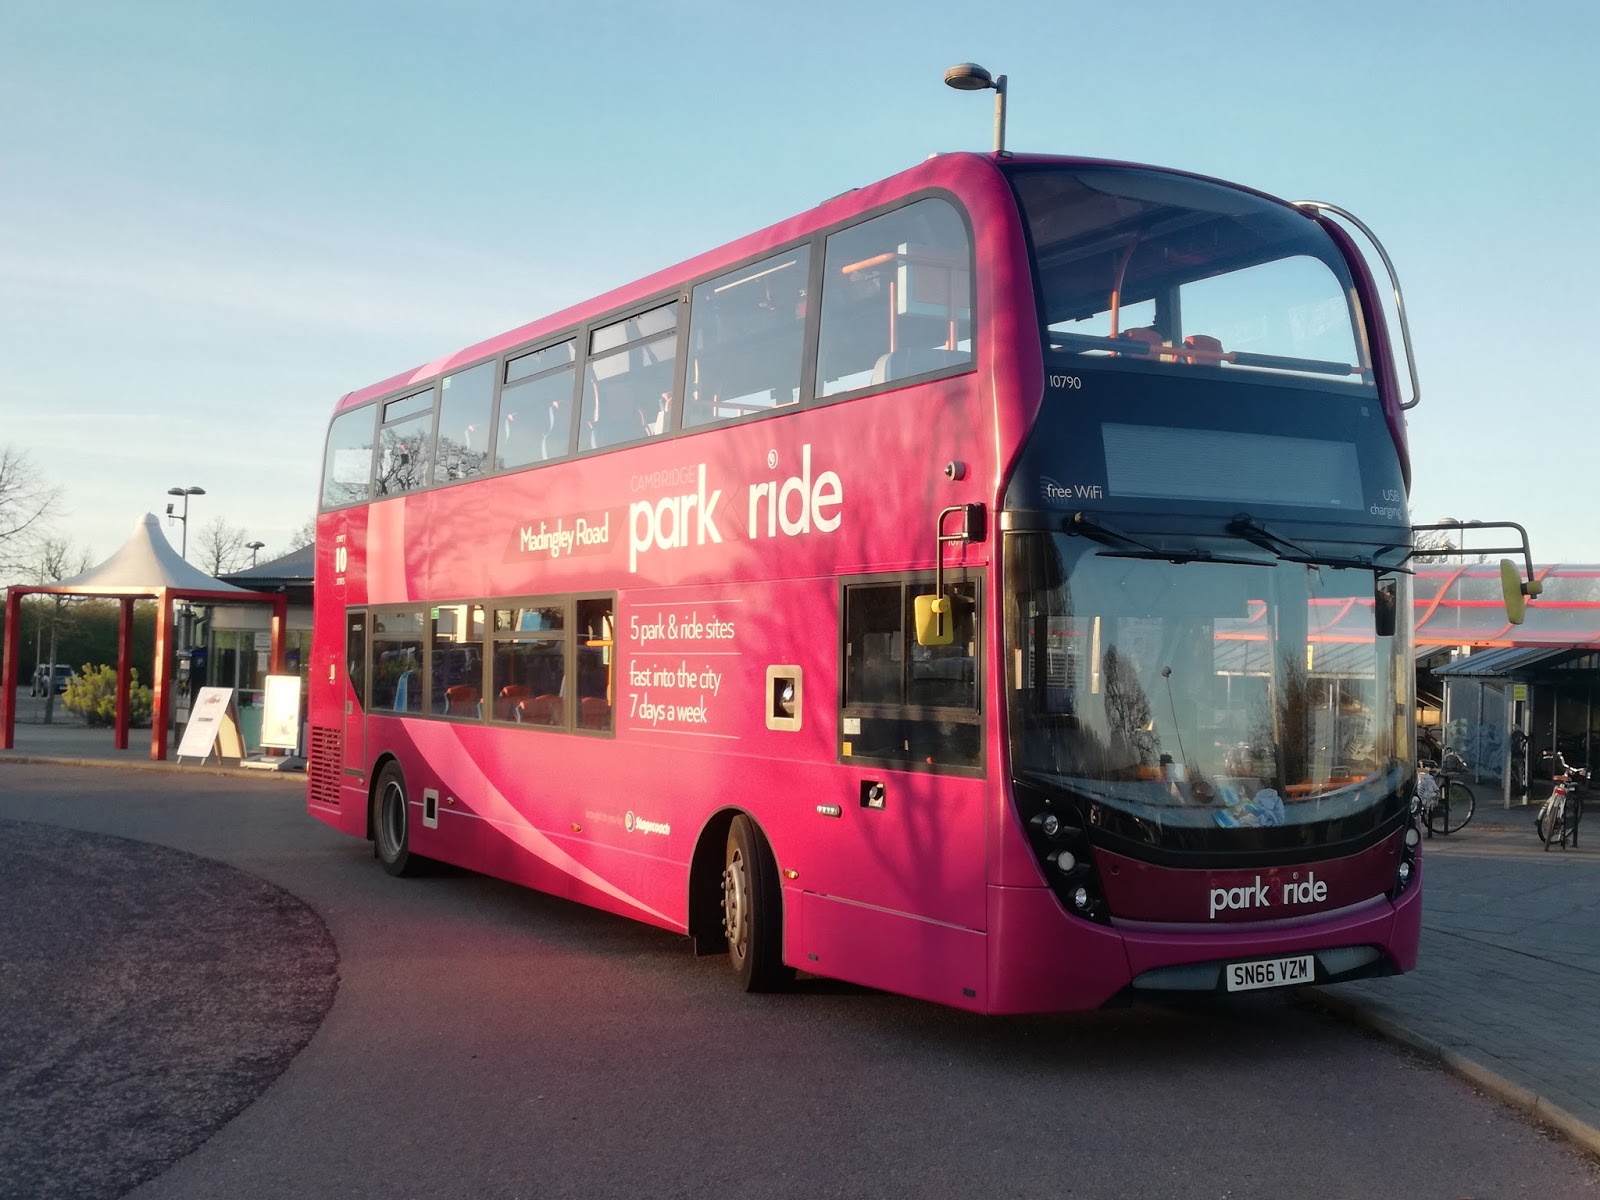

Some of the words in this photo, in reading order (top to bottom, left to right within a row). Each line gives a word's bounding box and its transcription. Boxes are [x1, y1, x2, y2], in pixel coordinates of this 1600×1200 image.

[1050, 374, 1082, 389] 10790
[630, 465, 697, 492] CAMBRIDGE
[1047, 483, 1072, 498] free
[1074, 484, 1103, 499] WiFi
[629, 463, 723, 574] park
[748, 443, 843, 540] ride
[1382, 489, 1400, 502] USB
[1370, 503, 1402, 520] charging
[520, 518, 575, 558] Madingley
[576, 511, 609, 546] Road
[335, 546, 348, 573] 10
[630, 615, 639, 640] 5
[641, 612, 665, 646] park
[667, 614, 678, 639] &
[680, 611, 703, 639] ride
[705, 614, 735, 639] sites
[629, 659, 651, 687] fast
[653, 664, 675, 688] into
[677, 660, 697, 688] the
[699, 665, 721, 697] city
[629, 693, 638, 718] 7
[639, 692, 665, 727] days
[667, 704, 675, 721] a
[677, 694, 708, 724] week
[1209, 875, 1271, 919] park
[1283, 871, 1328, 905] ride
[1234, 963, 1276, 986] SN66
[1279, 960, 1308, 980] VZM
